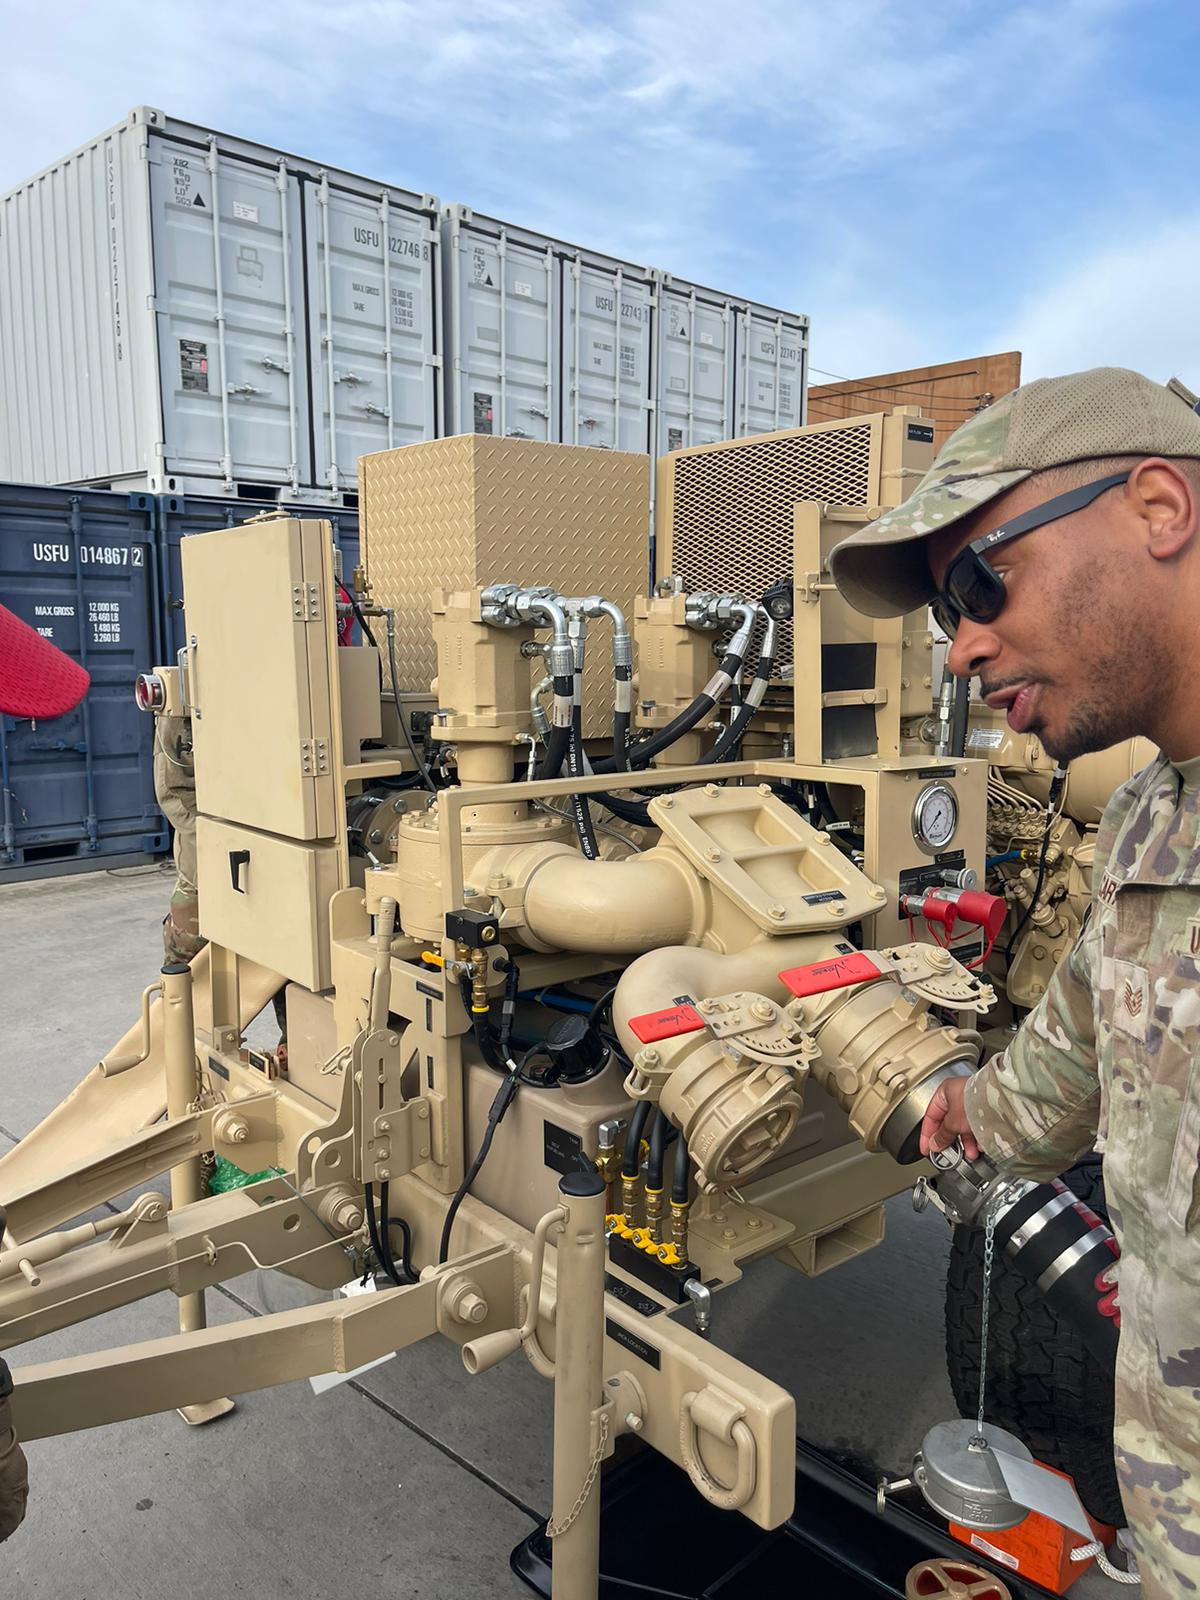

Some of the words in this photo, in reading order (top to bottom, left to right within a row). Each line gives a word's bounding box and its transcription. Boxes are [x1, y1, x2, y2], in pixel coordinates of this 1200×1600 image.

[353, 227, 379, 247] USFU
[423, 245, 429, 261] 8
[595, 295, 613, 312] USFU
[621, 303, 641, 322] 22743
[780, 346, 796, 360] 22747
[33, 543, 69, 562] USFU
[80, 545, 128, 565] 014867
[88, 602, 110, 612] 12.000
[110, 603, 119, 612] KG
[110, 613, 119, 622] LB
[111, 623, 120, 633] KG
[111, 633, 120, 642] LB
